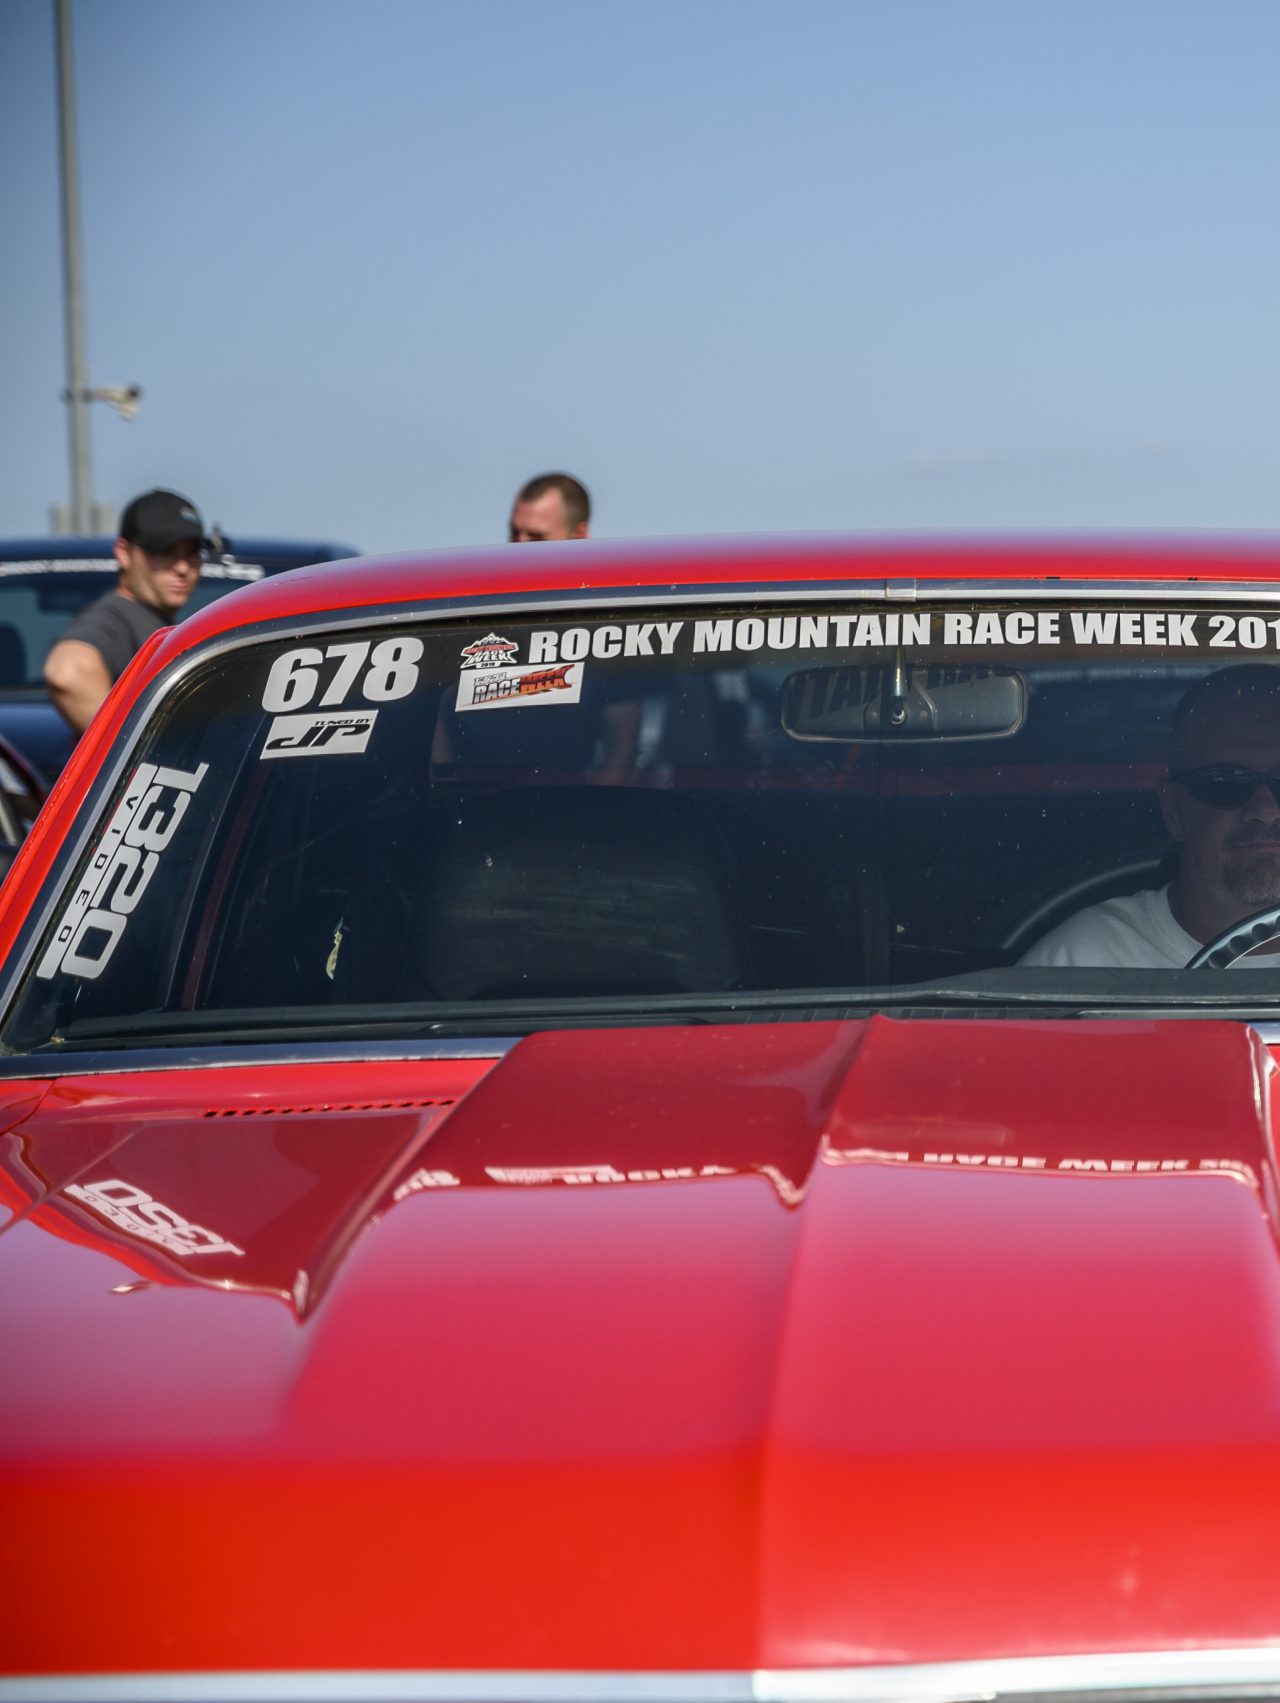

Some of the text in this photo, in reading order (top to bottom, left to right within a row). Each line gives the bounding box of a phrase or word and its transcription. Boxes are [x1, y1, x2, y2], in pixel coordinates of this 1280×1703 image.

[261, 637, 424, 713] 678
[528, 621, 684, 664] ROCKY
[693, 613, 931, 653] MOUNTAIN
[943, 612, 1061, 645] RACE
[1070, 612, 1199, 647] WEEK
[57, 795, 139, 943] VIDEO
[60, 762, 210, 980] 1320
